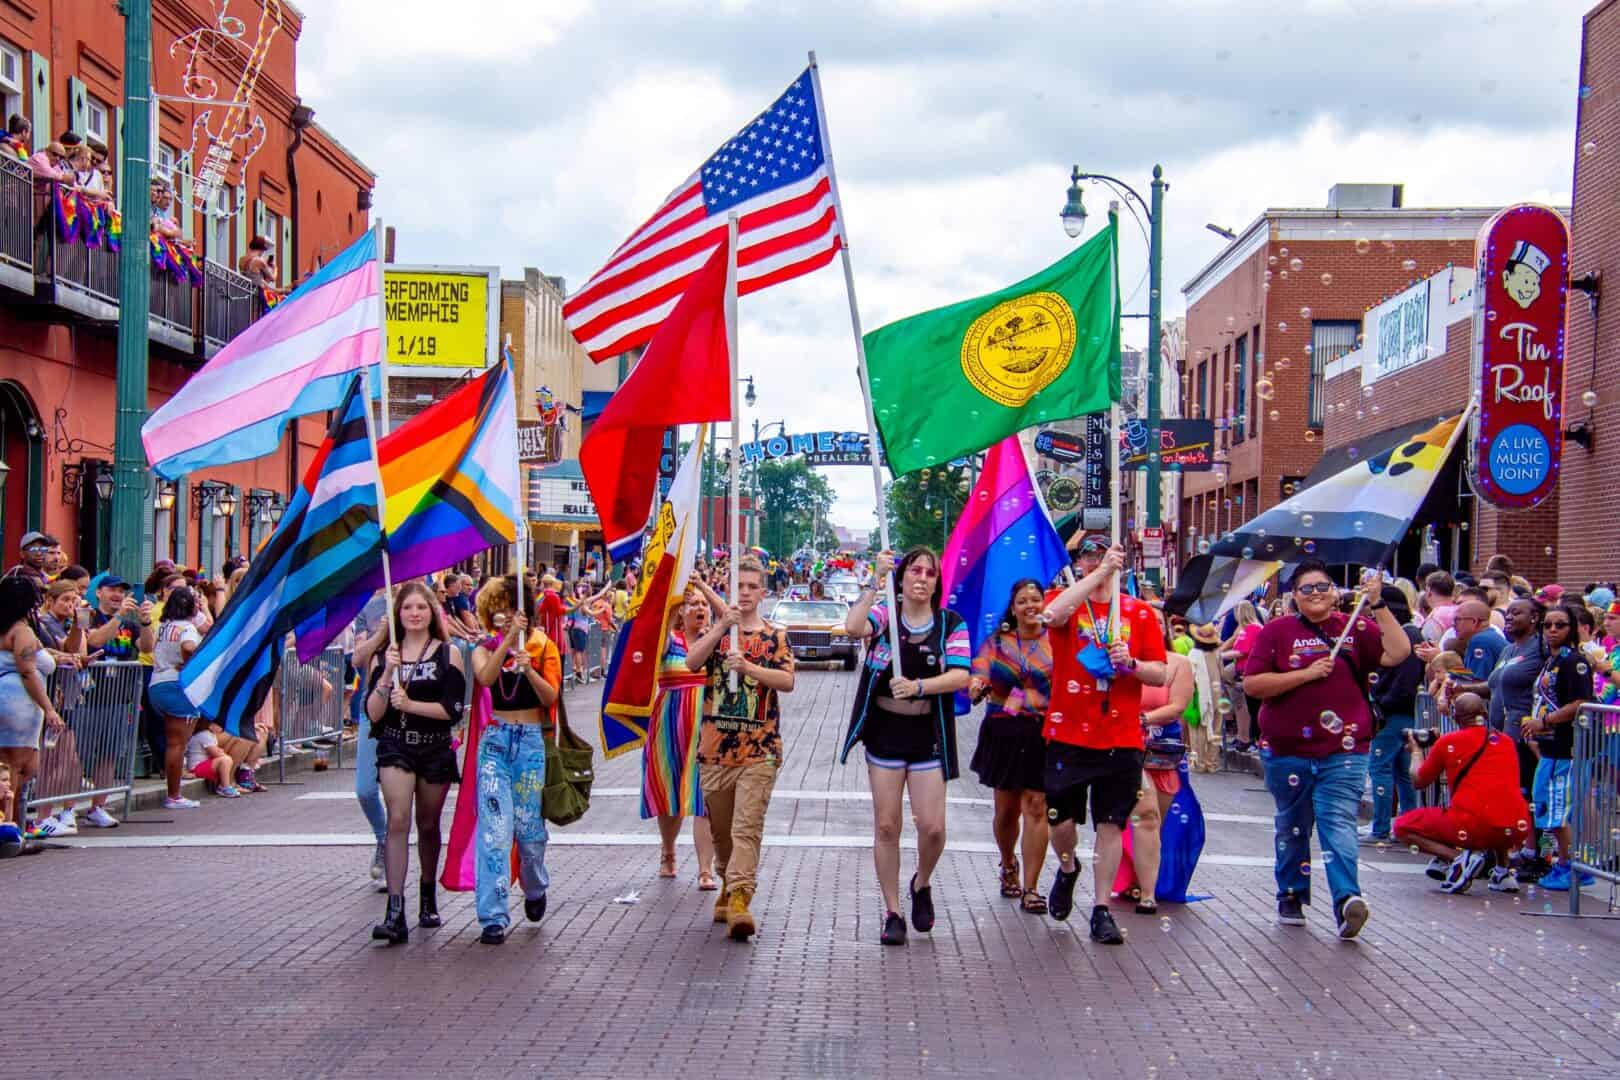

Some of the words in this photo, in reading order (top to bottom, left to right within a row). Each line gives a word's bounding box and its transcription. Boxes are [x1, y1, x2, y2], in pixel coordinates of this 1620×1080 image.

[386, 301, 459, 323] MEMPHIS
[397, 335, 436, 357] 1/19
[1500, 322, 1551, 362] Tin
[1490, 363, 1555, 420] Roof
[742, 432, 836, 464] HOME
[1498, 438, 1509, 449] A
[1513, 437, 1542, 449] LIVE
[1091, 418, 1103, 505] MUSEUM
[1496, 453, 1544, 465] MUSIC
[1498, 468, 1541, 480] JOINT
[563, 504, 590, 514] BEALE
